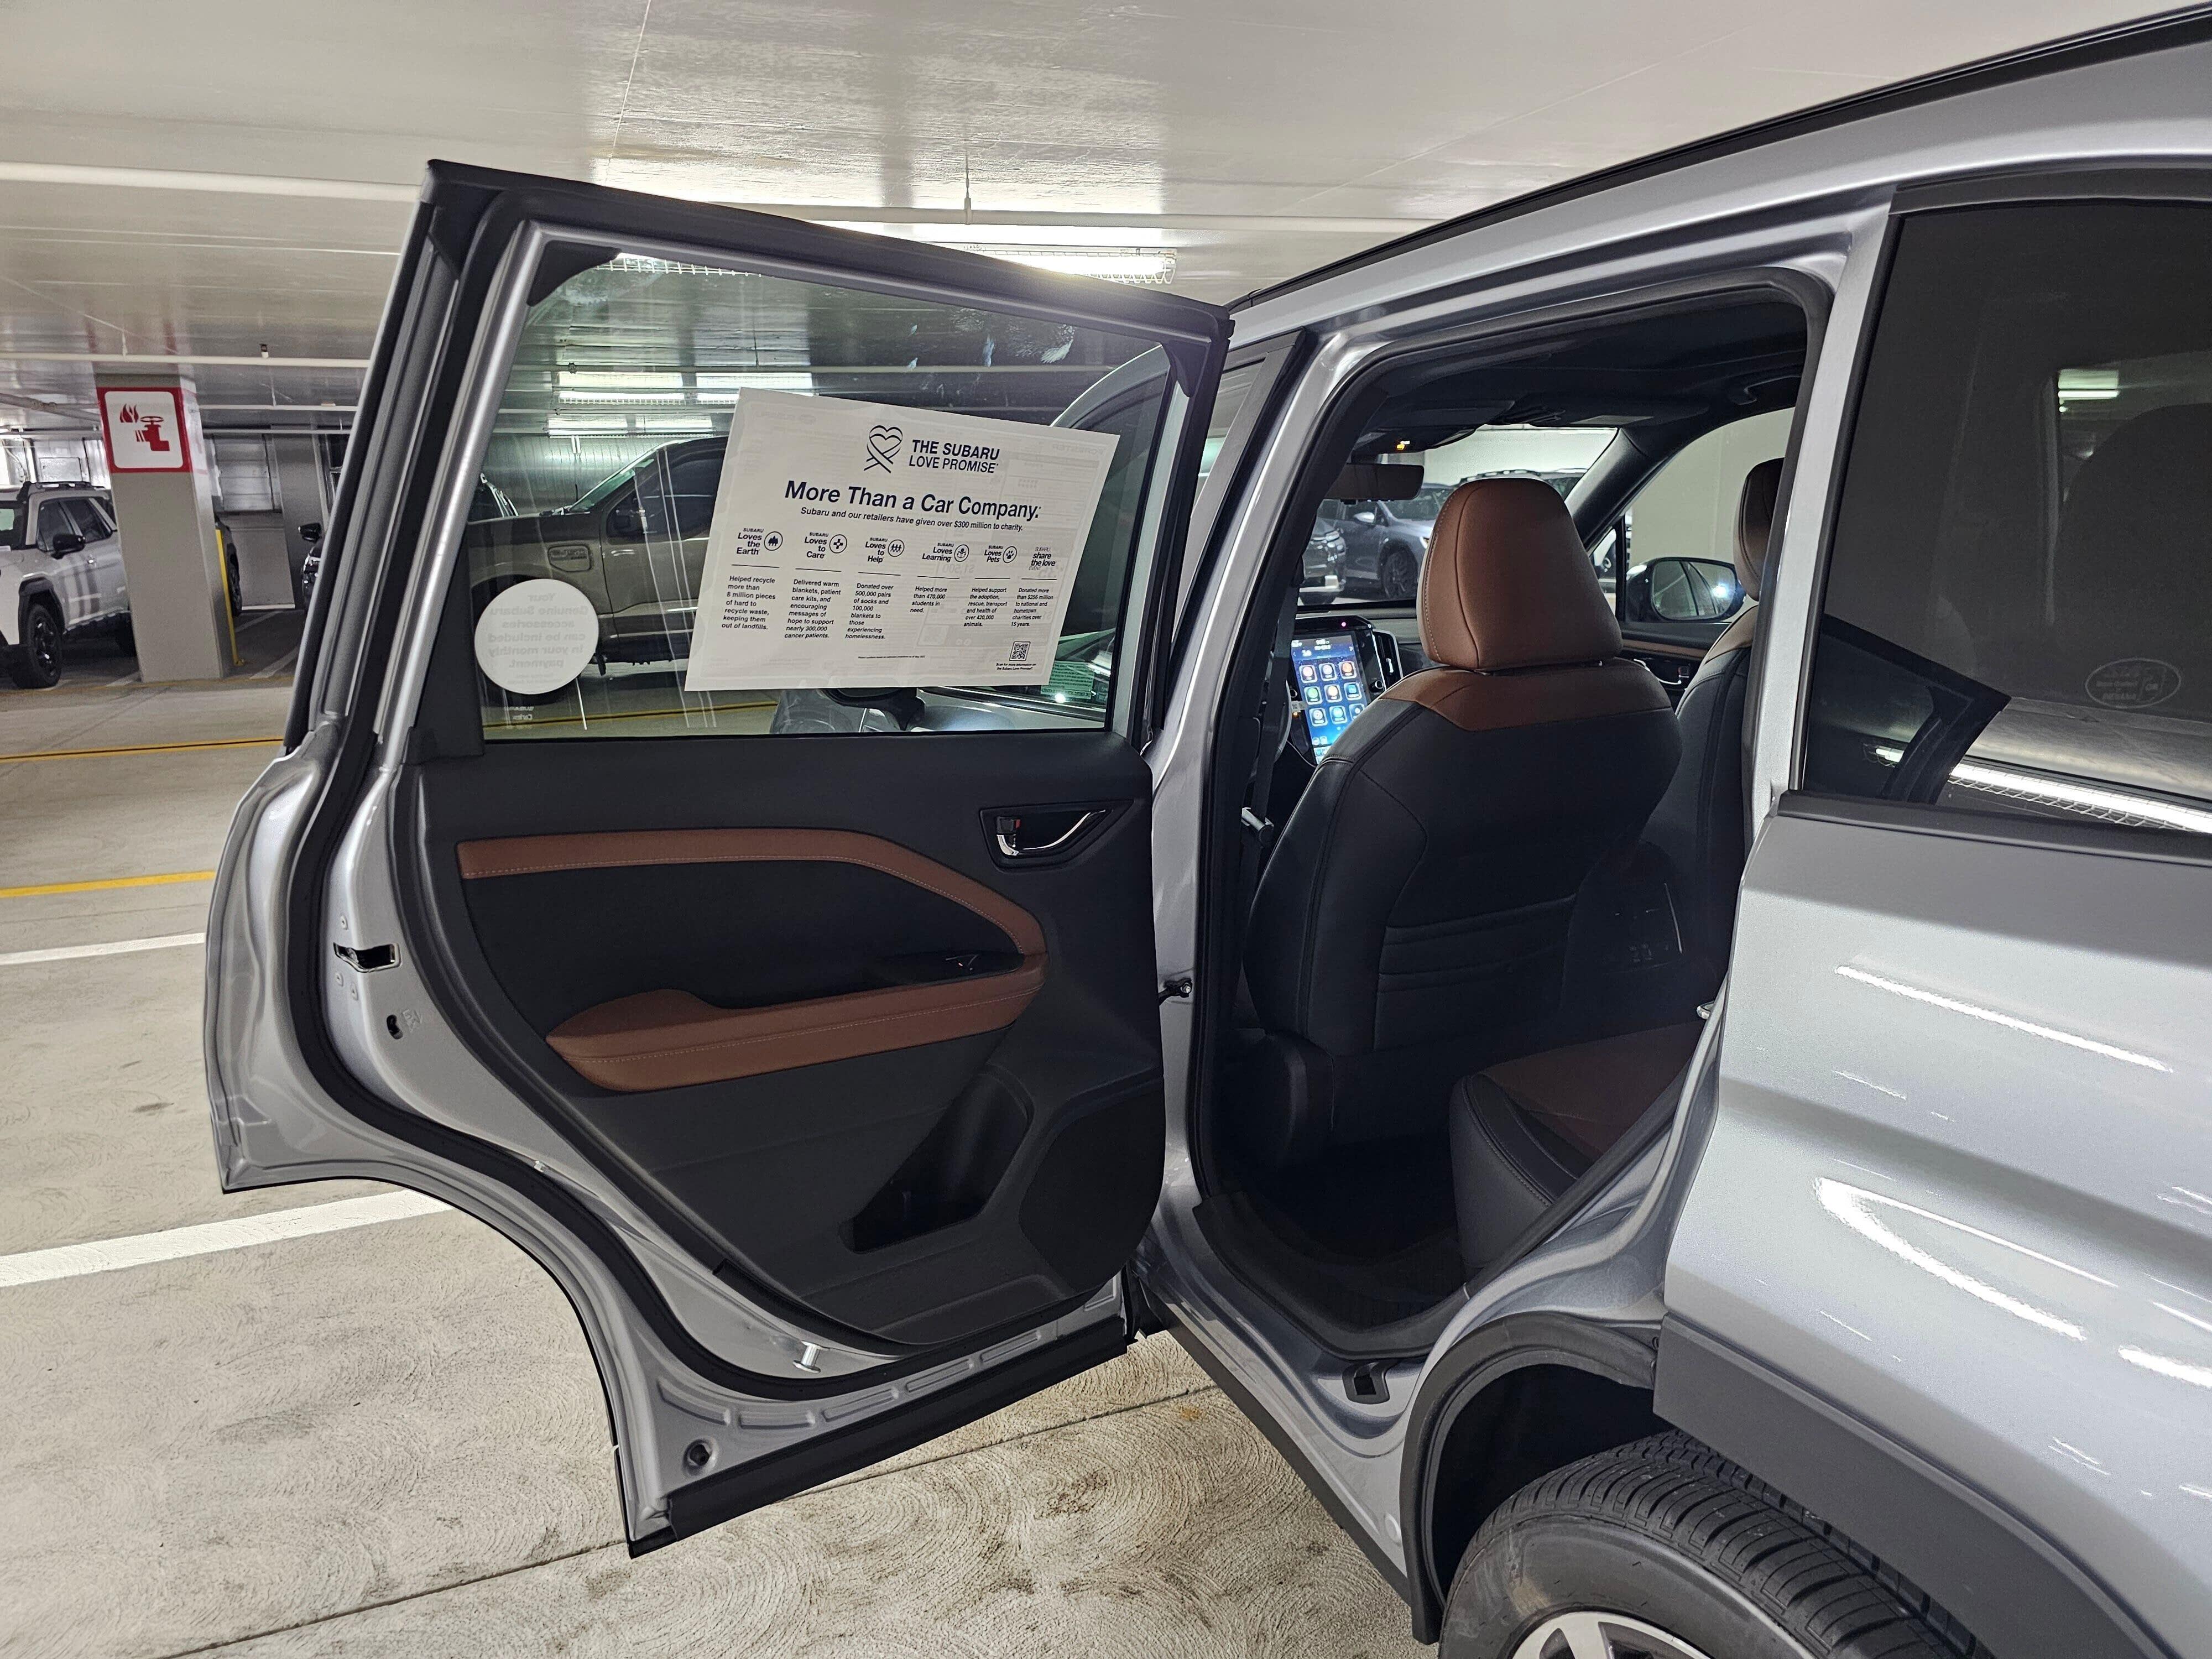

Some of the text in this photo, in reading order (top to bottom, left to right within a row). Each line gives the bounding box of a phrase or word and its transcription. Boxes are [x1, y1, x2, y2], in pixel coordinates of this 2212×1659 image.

[912, 440, 1000, 460] THE SUBARU
[909, 455, 998, 473] LOVE PROMISE
[785, 481, 1041, 521] More Than a Car Company.
[801, 507, 830, 516] Subaru
[916, 518, 935, 526] given
[1001, 524, 1022, 532] charity.
[805, 536, 827, 545] Loves
[868, 555, 883, 564] Help
[922, 553, 952, 562] Learning
